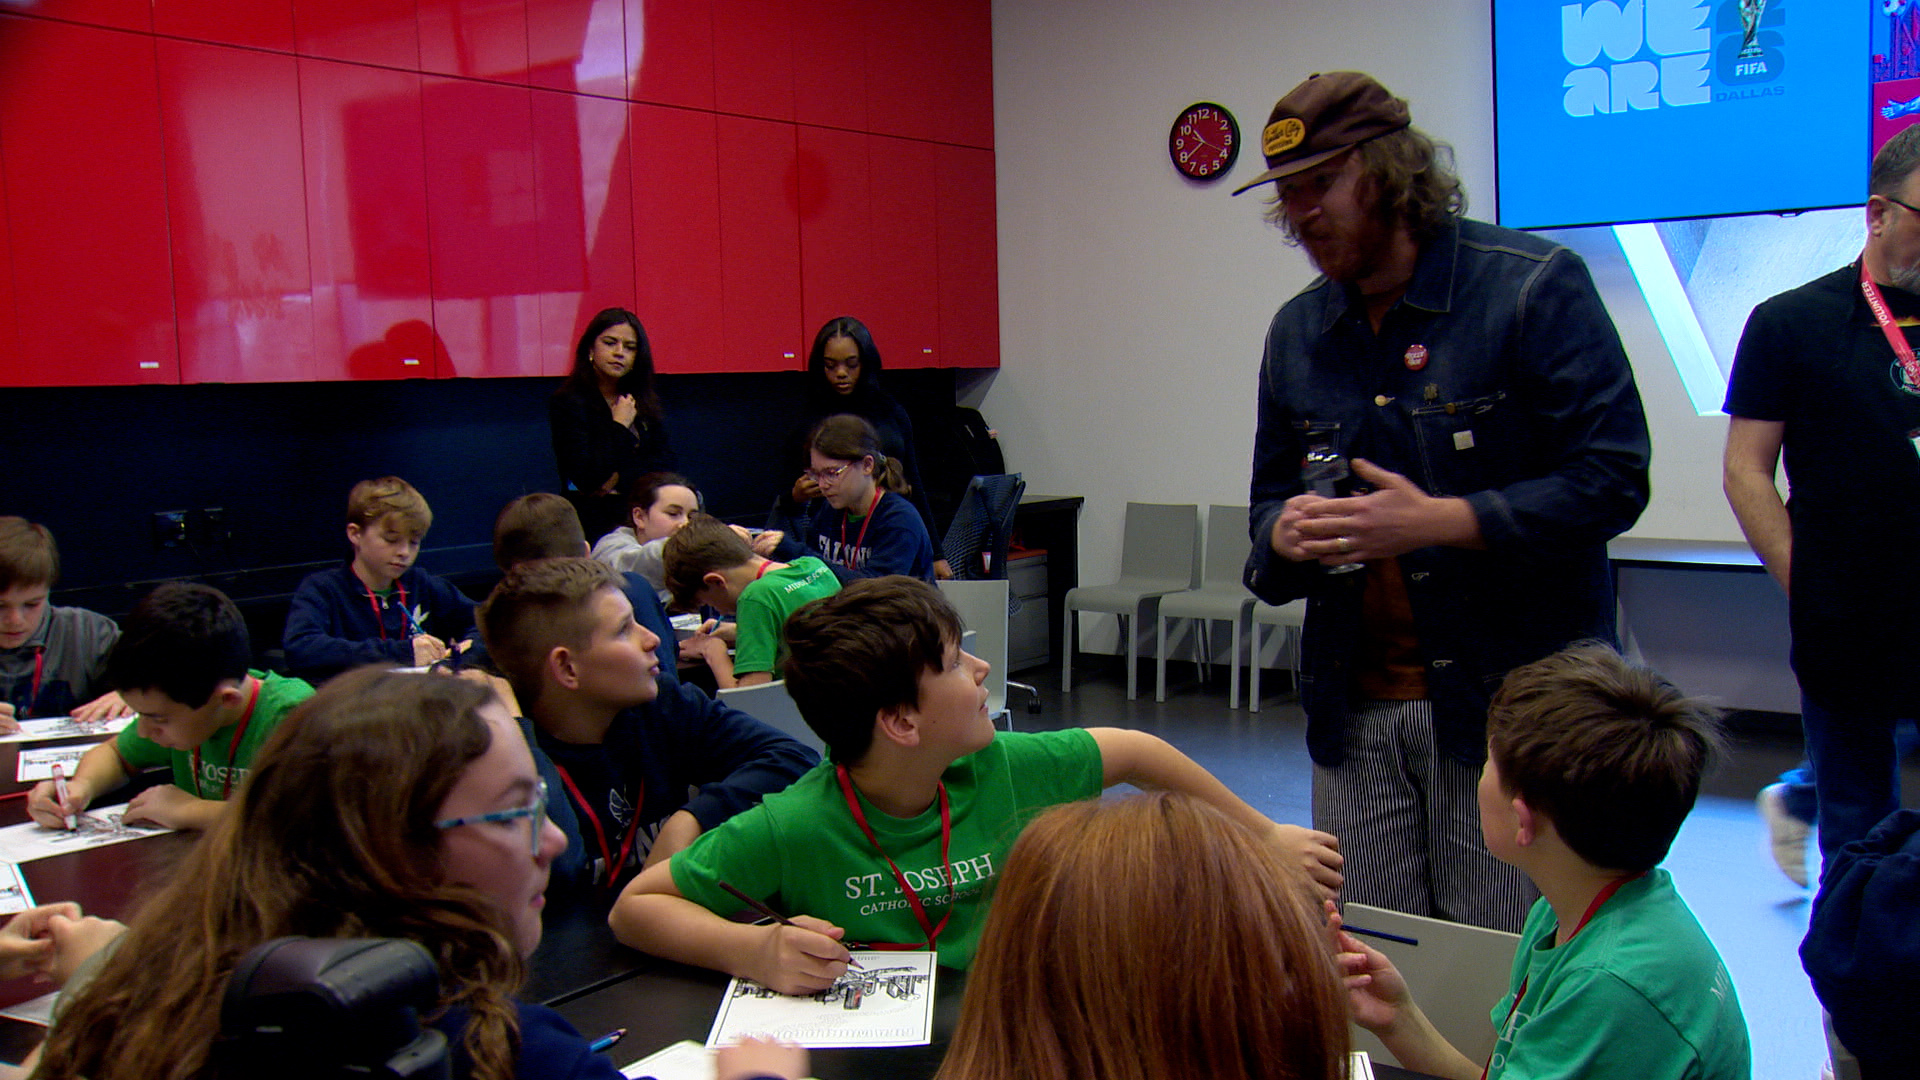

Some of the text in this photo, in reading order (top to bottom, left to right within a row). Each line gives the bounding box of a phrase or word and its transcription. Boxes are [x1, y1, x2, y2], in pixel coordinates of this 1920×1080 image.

[1735, 61, 1767, 76] FIFA
[1716, 86, 1784, 102] DALLAS
[1187, 113, 1197, 125] 11
[1197, 108, 1210, 120] 12
[1213, 111, 1218, 122] 1
[1180, 125, 1191, 136] 10
[1220, 119, 1228, 130] 2
[1175, 138, 1184, 150] 9
[1224, 134, 1232, 146] 3
[1180, 151, 1188, 163] 8
[1219, 148, 1228, 159] 4
[1189, 161, 1197, 172] 7
[1199, 164, 1208, 176] 6
[1212, 160, 1220, 170] 5
[1861, 280, 1890, 327] VOLUNTEER
[845, 873, 885, 899] ST.
